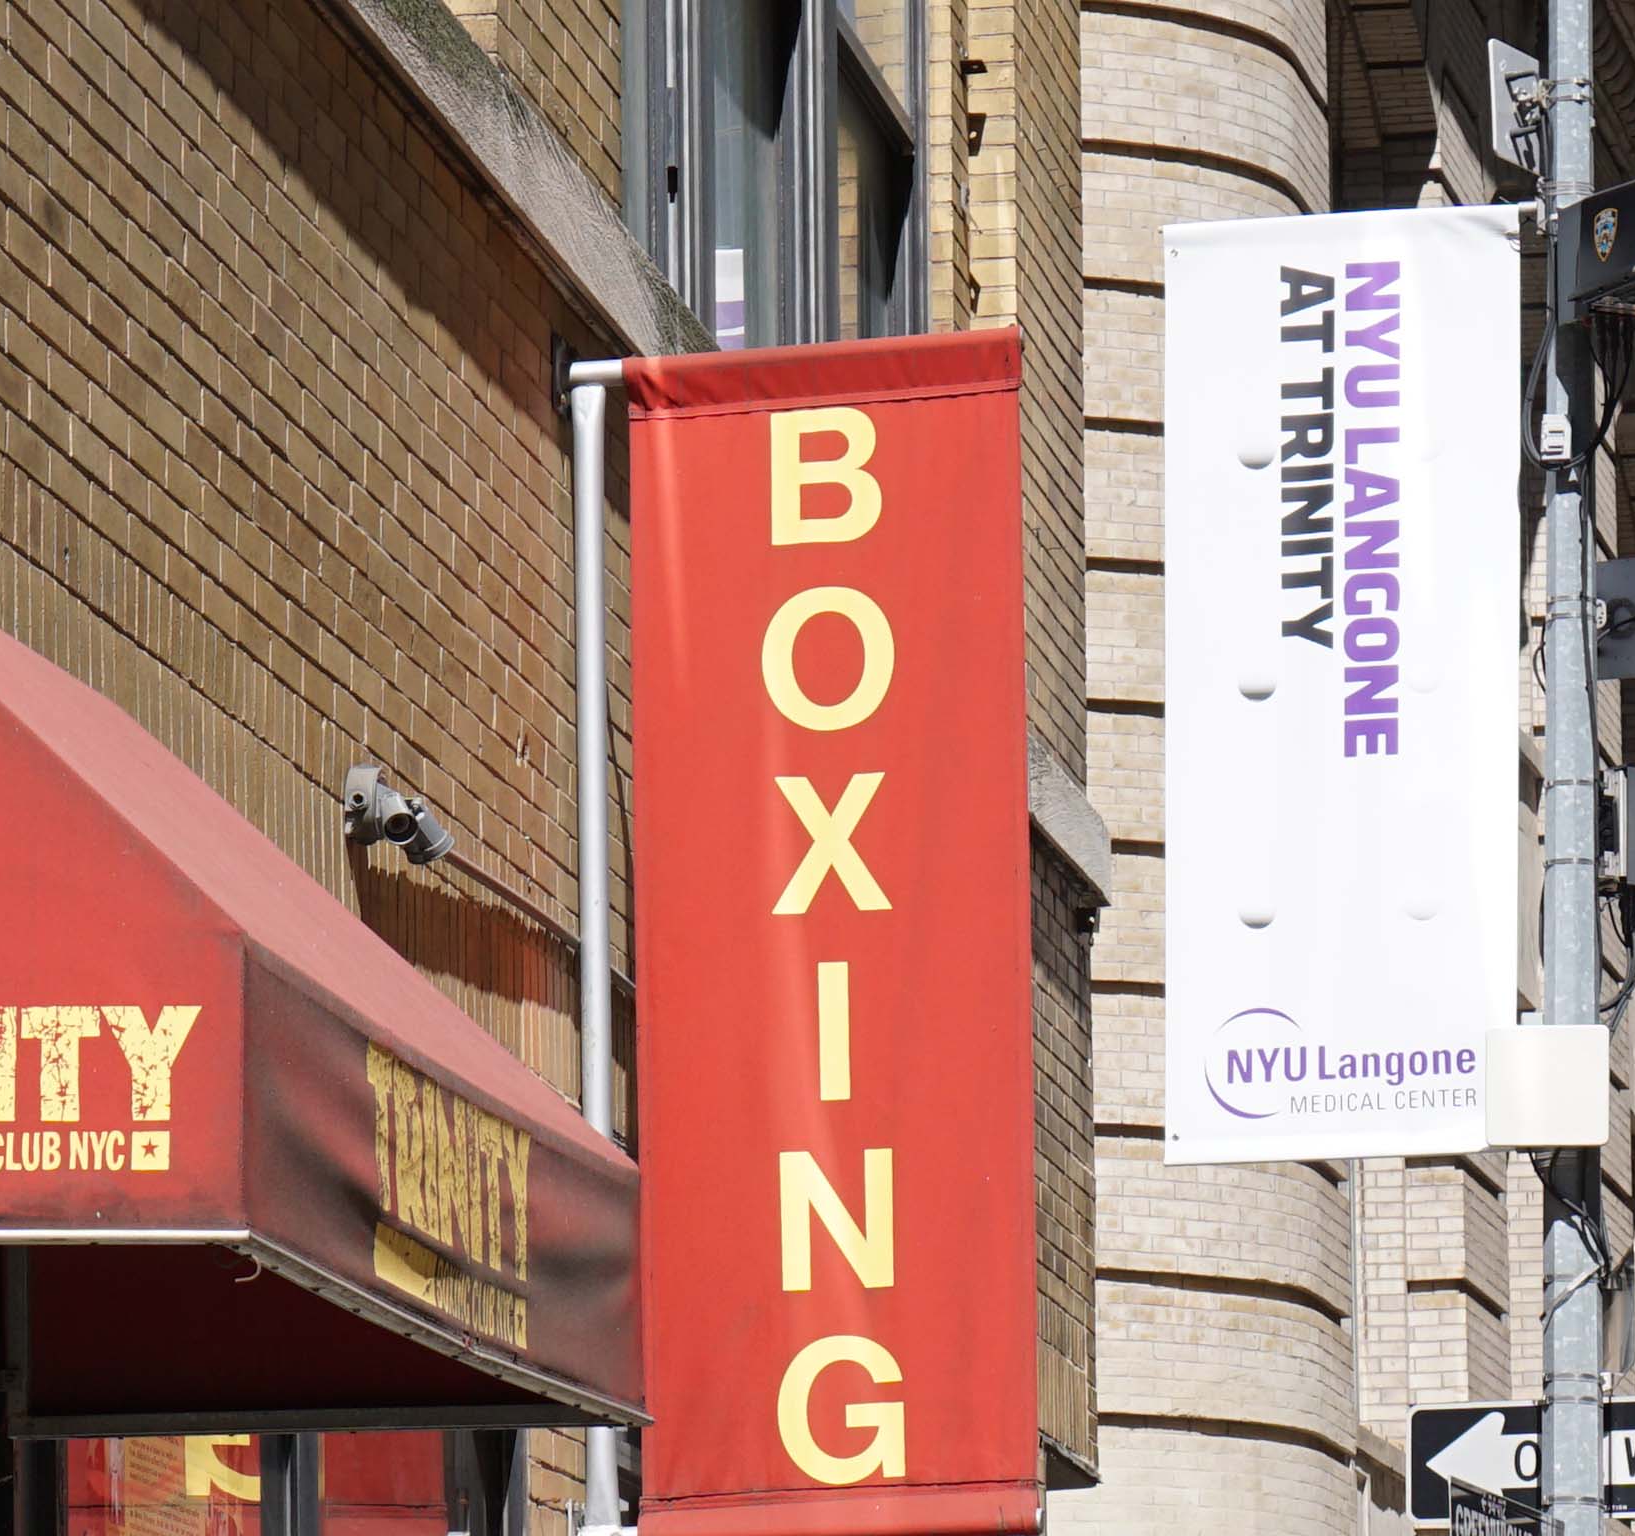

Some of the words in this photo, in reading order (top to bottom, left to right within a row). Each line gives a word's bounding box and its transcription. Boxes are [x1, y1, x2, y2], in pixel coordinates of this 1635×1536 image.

[1280, 265, 1335, 354] AT
[1344, 261, 1401, 409] NYU
[1280, 366, 1335, 650] TRINITY
[1343, 426, 1401, 758] LANGONE
[761, 406, 907, 1486] BOXING
[1226, 1045, 1307, 1084] NYU
[1317, 1044, 1477, 1087] Langone
[1290, 1091, 1387, 1114] MEDICAL
[1394, 1088, 1478, 1111] CENTER
[68, 1130, 126, 1171] NYC
[367, 1041, 532, 1283] TRINITY
